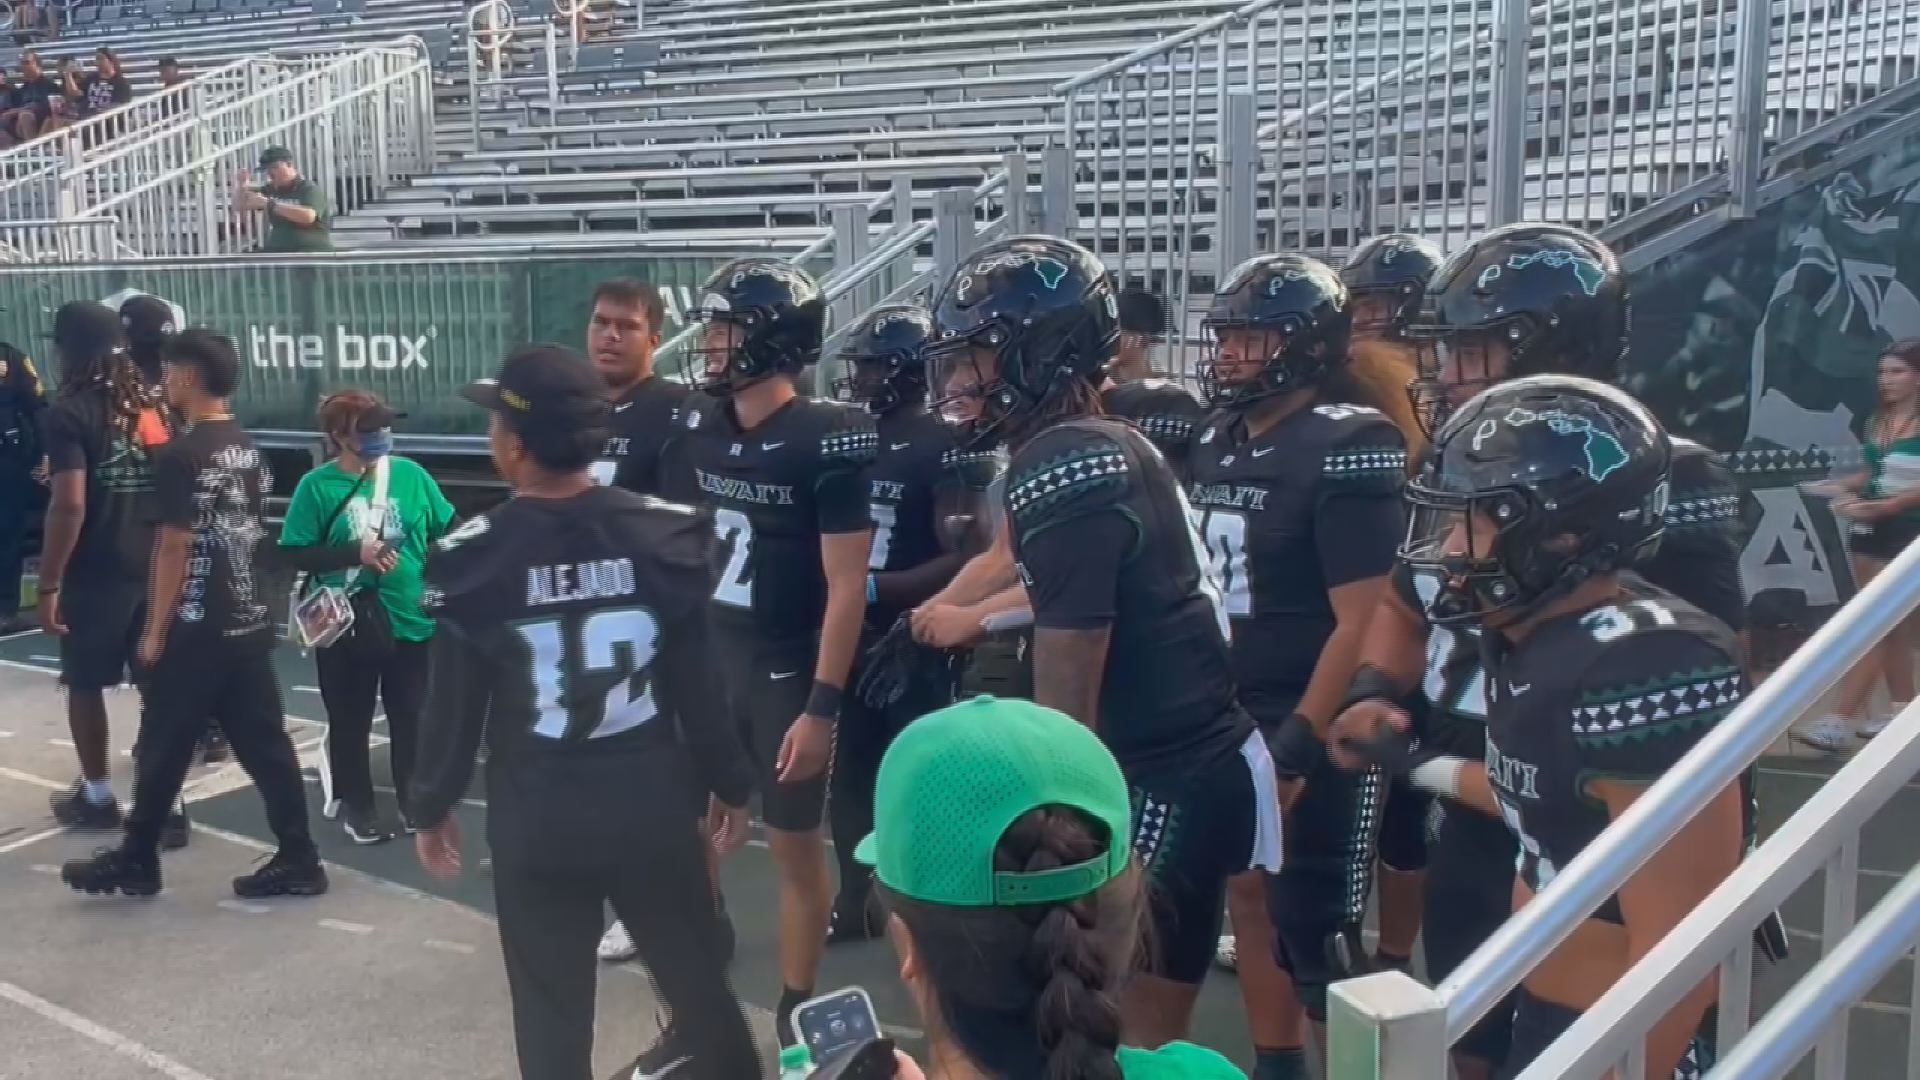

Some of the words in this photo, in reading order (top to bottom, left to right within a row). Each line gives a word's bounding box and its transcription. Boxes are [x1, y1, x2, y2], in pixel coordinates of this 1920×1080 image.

[251, 324, 324, 368] the
[337, 324, 428, 369] box
[526, 557, 637, 607] ALEJADO
[1578, 600, 1677, 643] 31
[515, 608, 660, 740] 12
